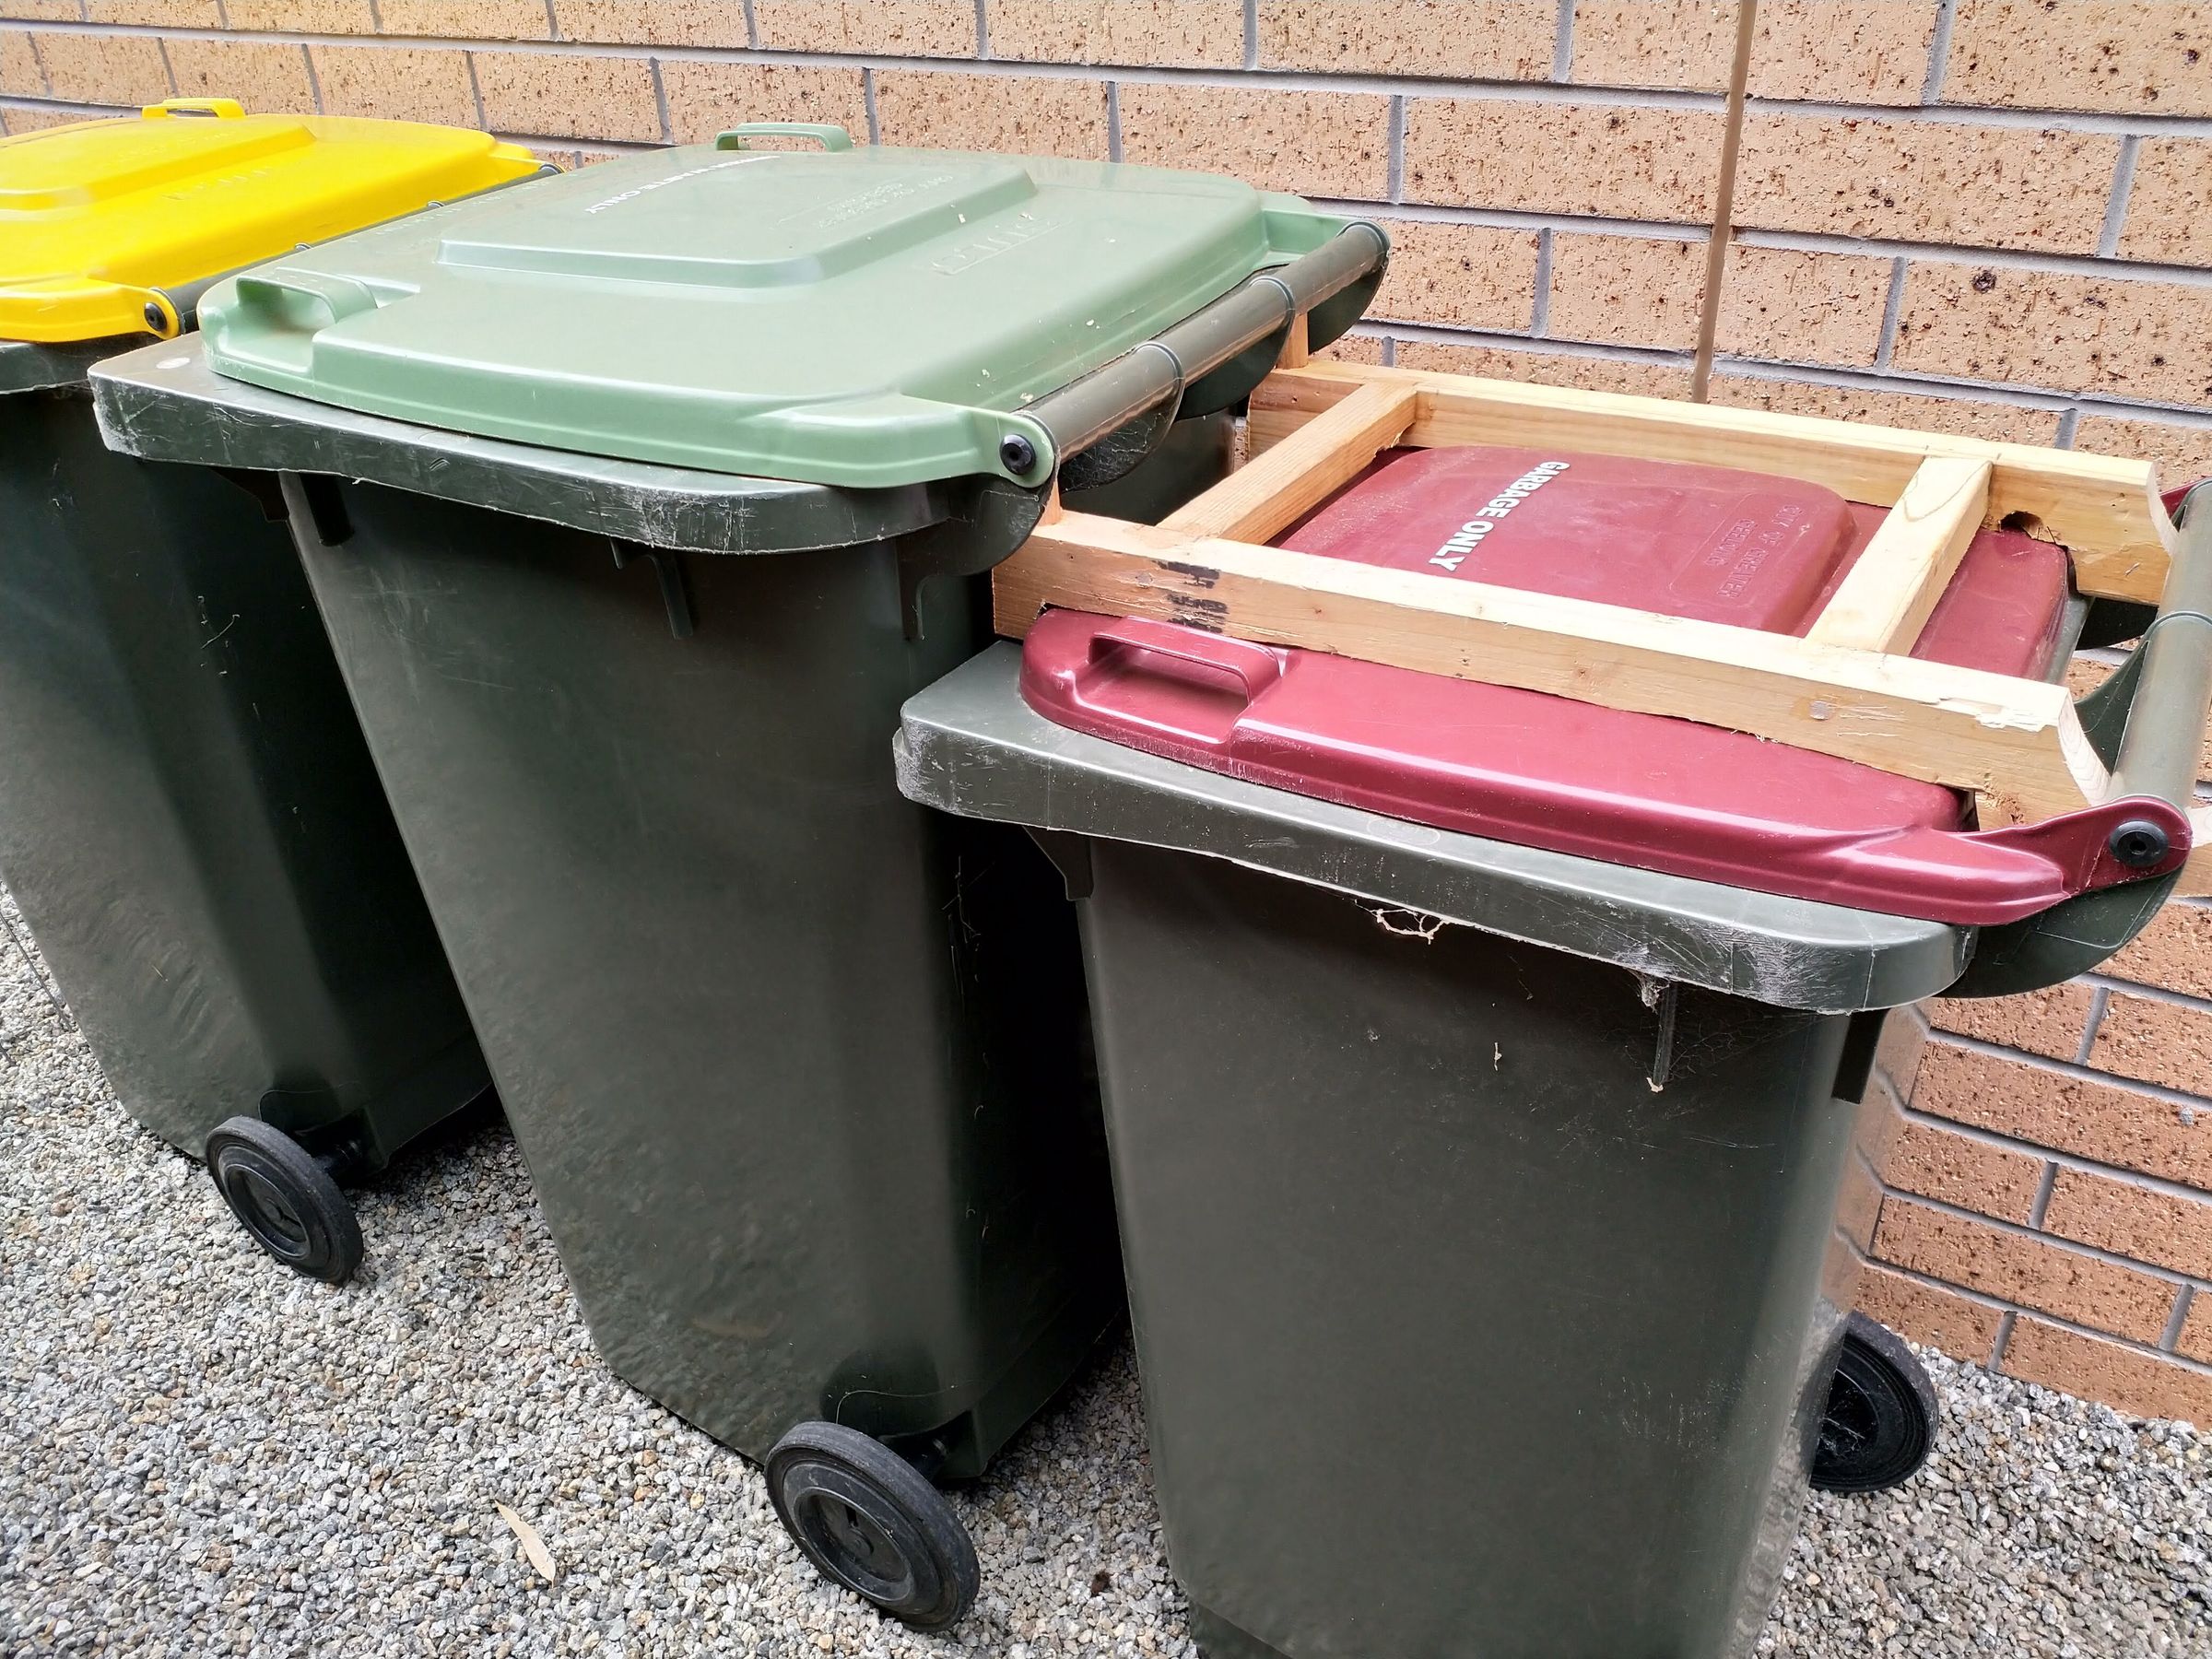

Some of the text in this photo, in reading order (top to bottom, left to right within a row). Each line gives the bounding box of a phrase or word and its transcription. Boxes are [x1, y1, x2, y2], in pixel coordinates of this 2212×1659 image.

[584, 190, 641, 214] ONLY
[1428, 461, 1571, 571] GARBAGE ONLY
[1771, 505, 1805, 528] CITY
[1759, 531, 1785, 547] OF
